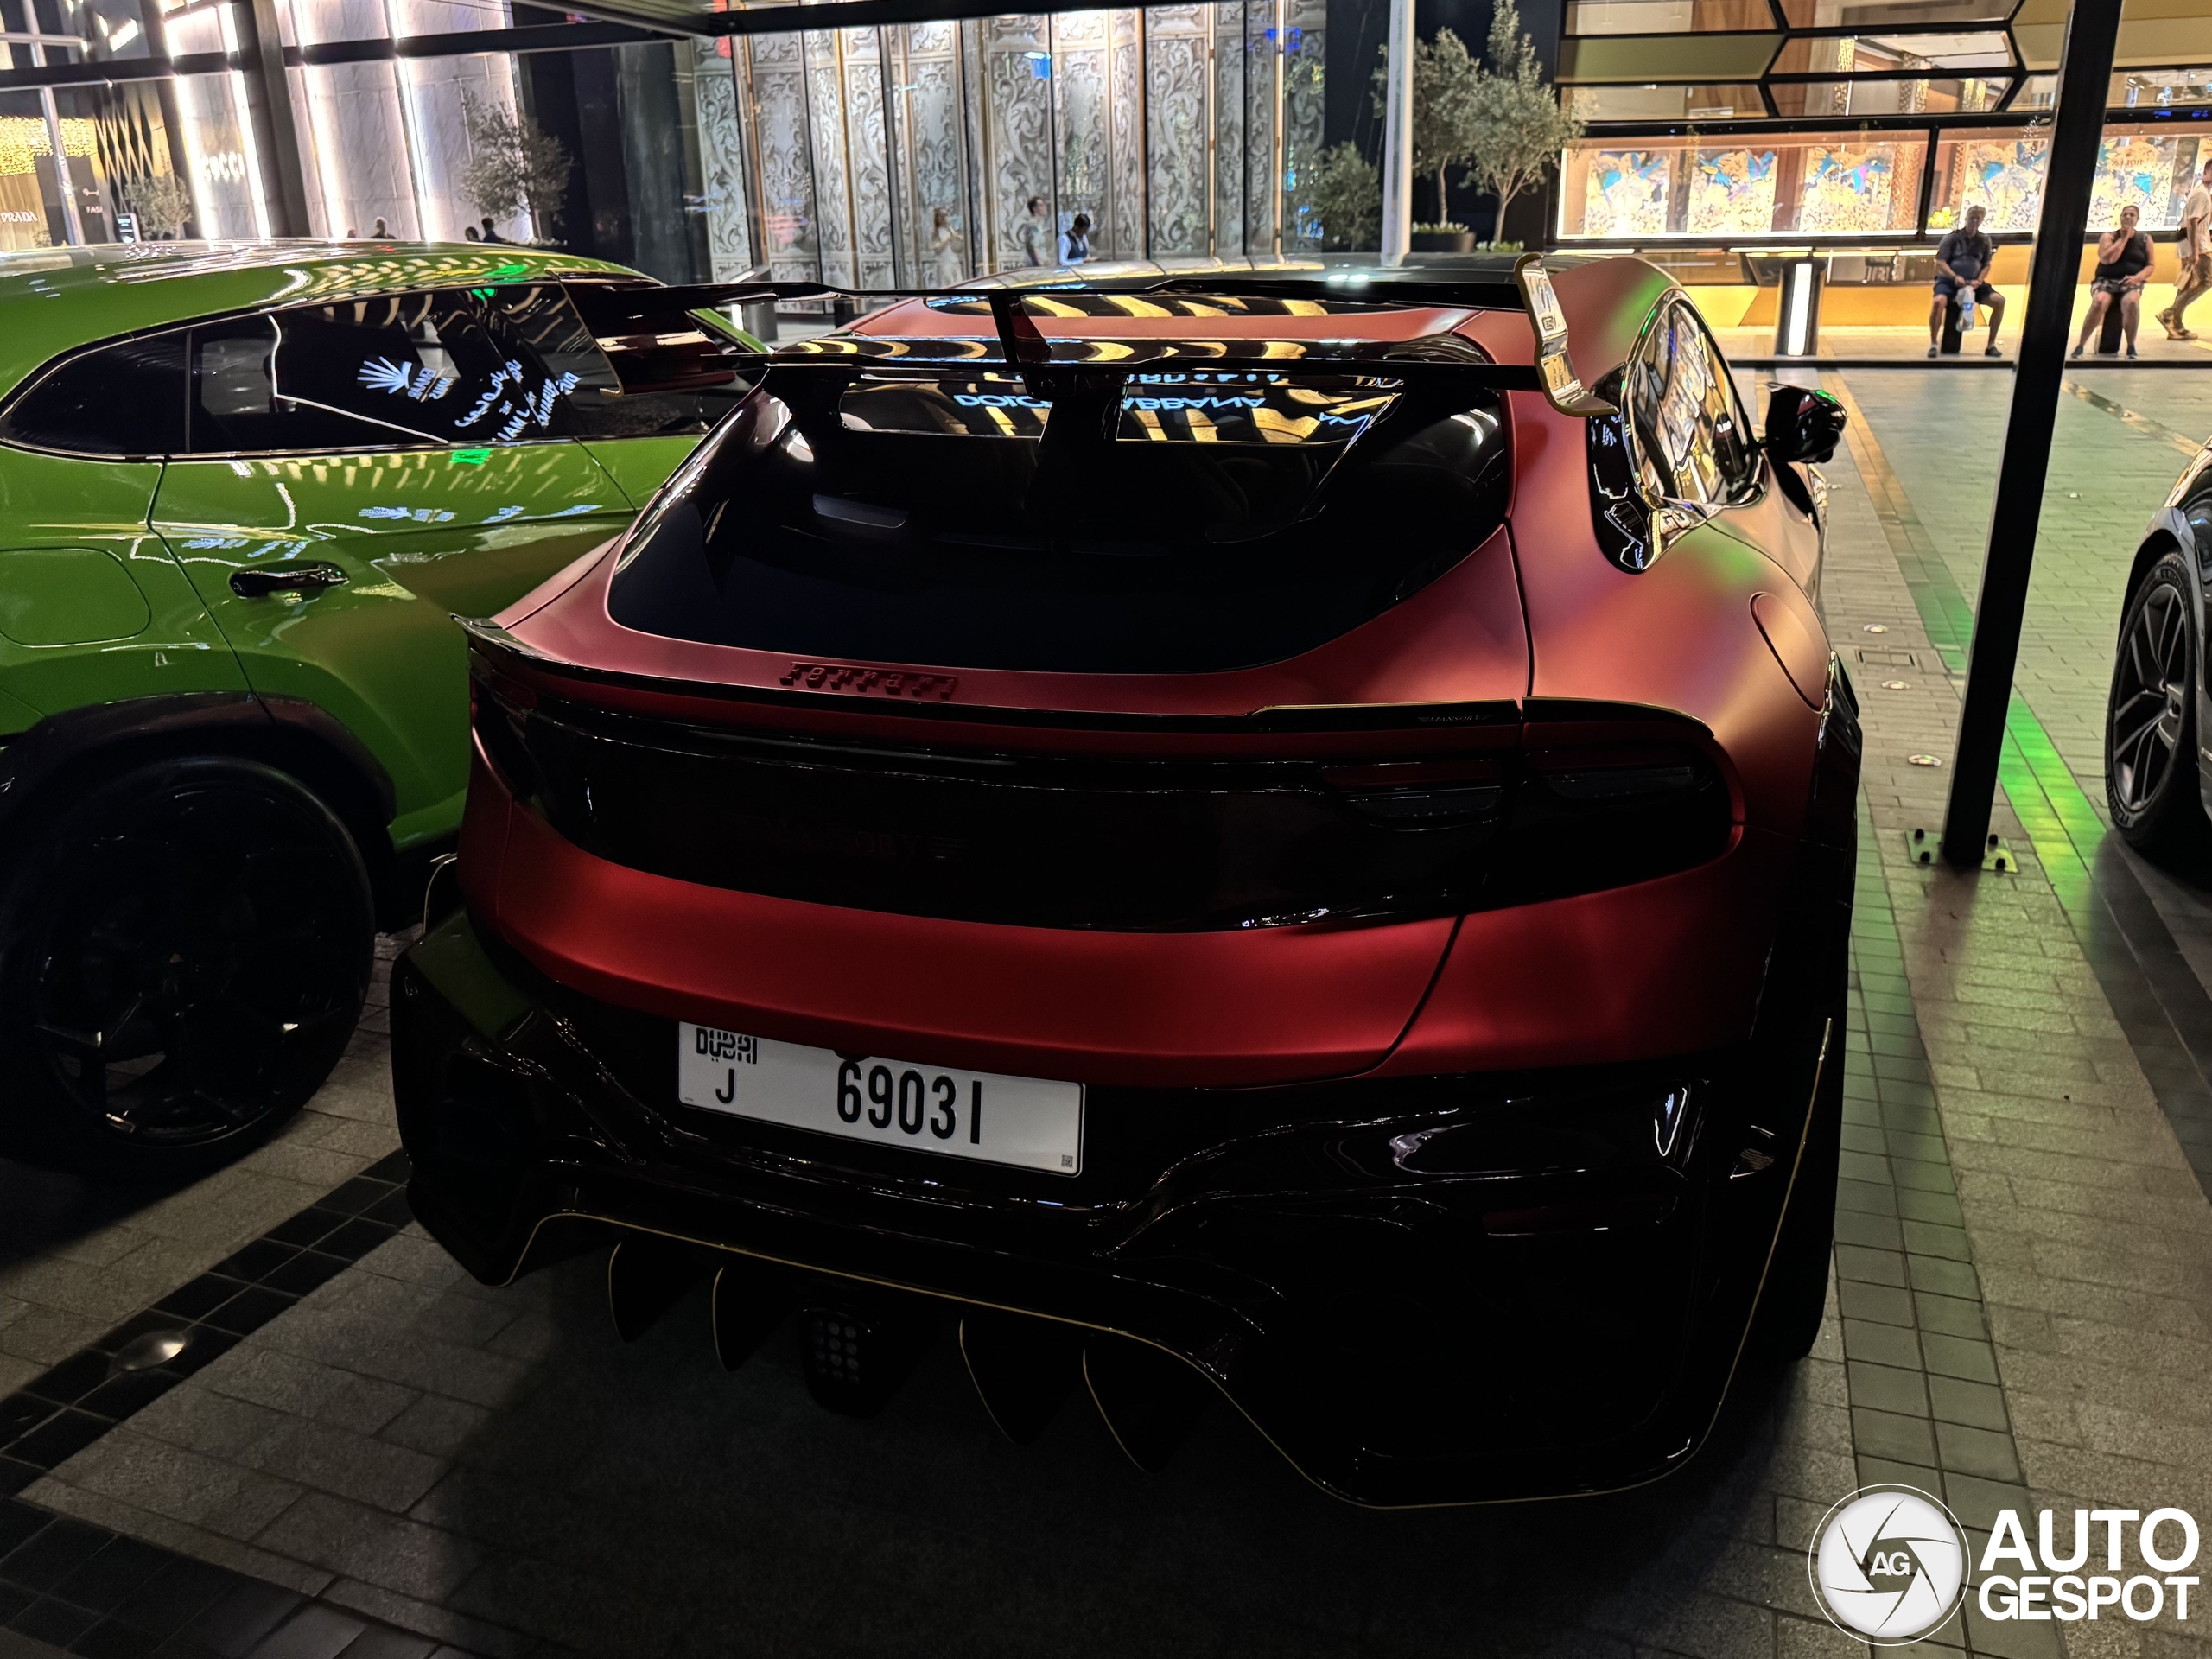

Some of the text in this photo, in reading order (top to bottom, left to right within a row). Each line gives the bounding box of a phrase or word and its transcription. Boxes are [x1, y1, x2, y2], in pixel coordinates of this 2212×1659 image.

[0, 211, 38, 223] PRADA
[779, 662, 958, 700] Ferrari
[715, 1060, 982, 1145] J 69031
